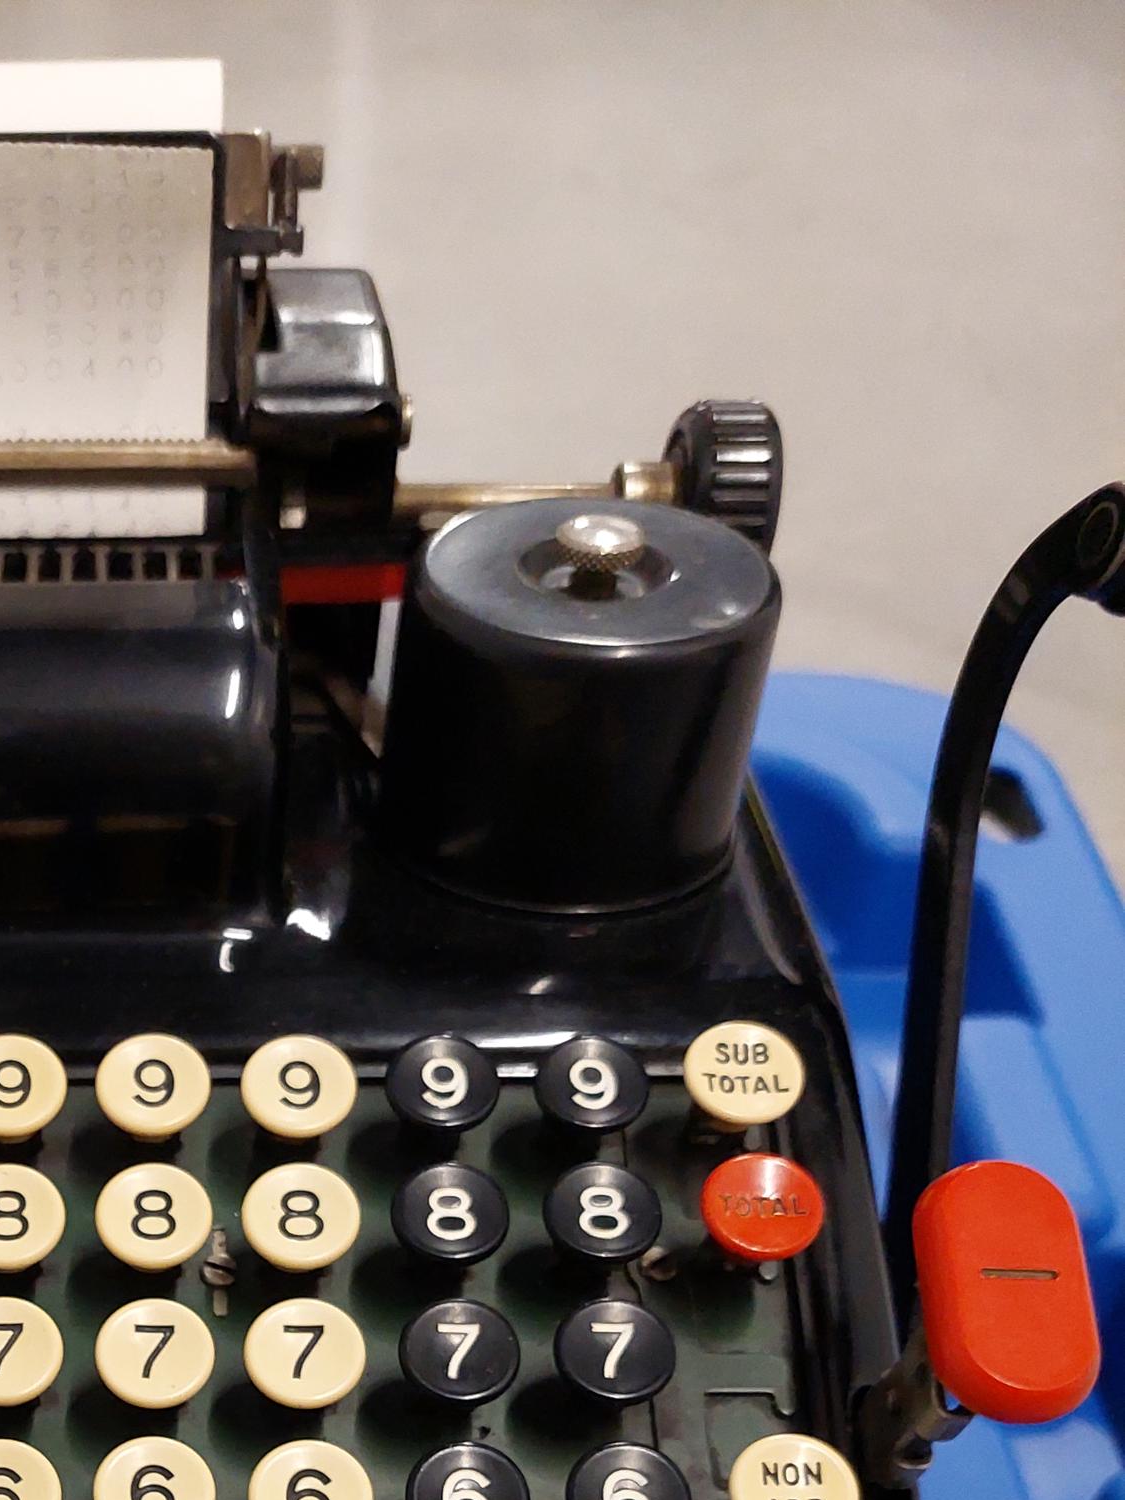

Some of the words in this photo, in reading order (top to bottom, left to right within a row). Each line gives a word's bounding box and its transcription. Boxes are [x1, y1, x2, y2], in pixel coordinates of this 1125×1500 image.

[714, 1041, 770, 1065] SUB
[133, 1058, 175, 1108] 9
[278, 1060, 321, 1110] 9
[421, 1058, 468, 1110] 9
[569, 1059, 617, 1110] 9
[701, 1072, 789, 1095] TOTAL
[130, 1189, 177, 1241] 8
[278, 1189, 325, 1241] 8
[426, 1187, 477, 1241] 8
[578, 1186, 629, 1240] 8
[717, 1193, 810, 1219] TOTAL
[134, 1324, 175, 1379] 7
[282, 1324, 325, 1380] 7
[437, 1323, 480, 1380] 7
[590, 1322, 634, 1379] 7
[761, 1461, 823, 1487] NON
